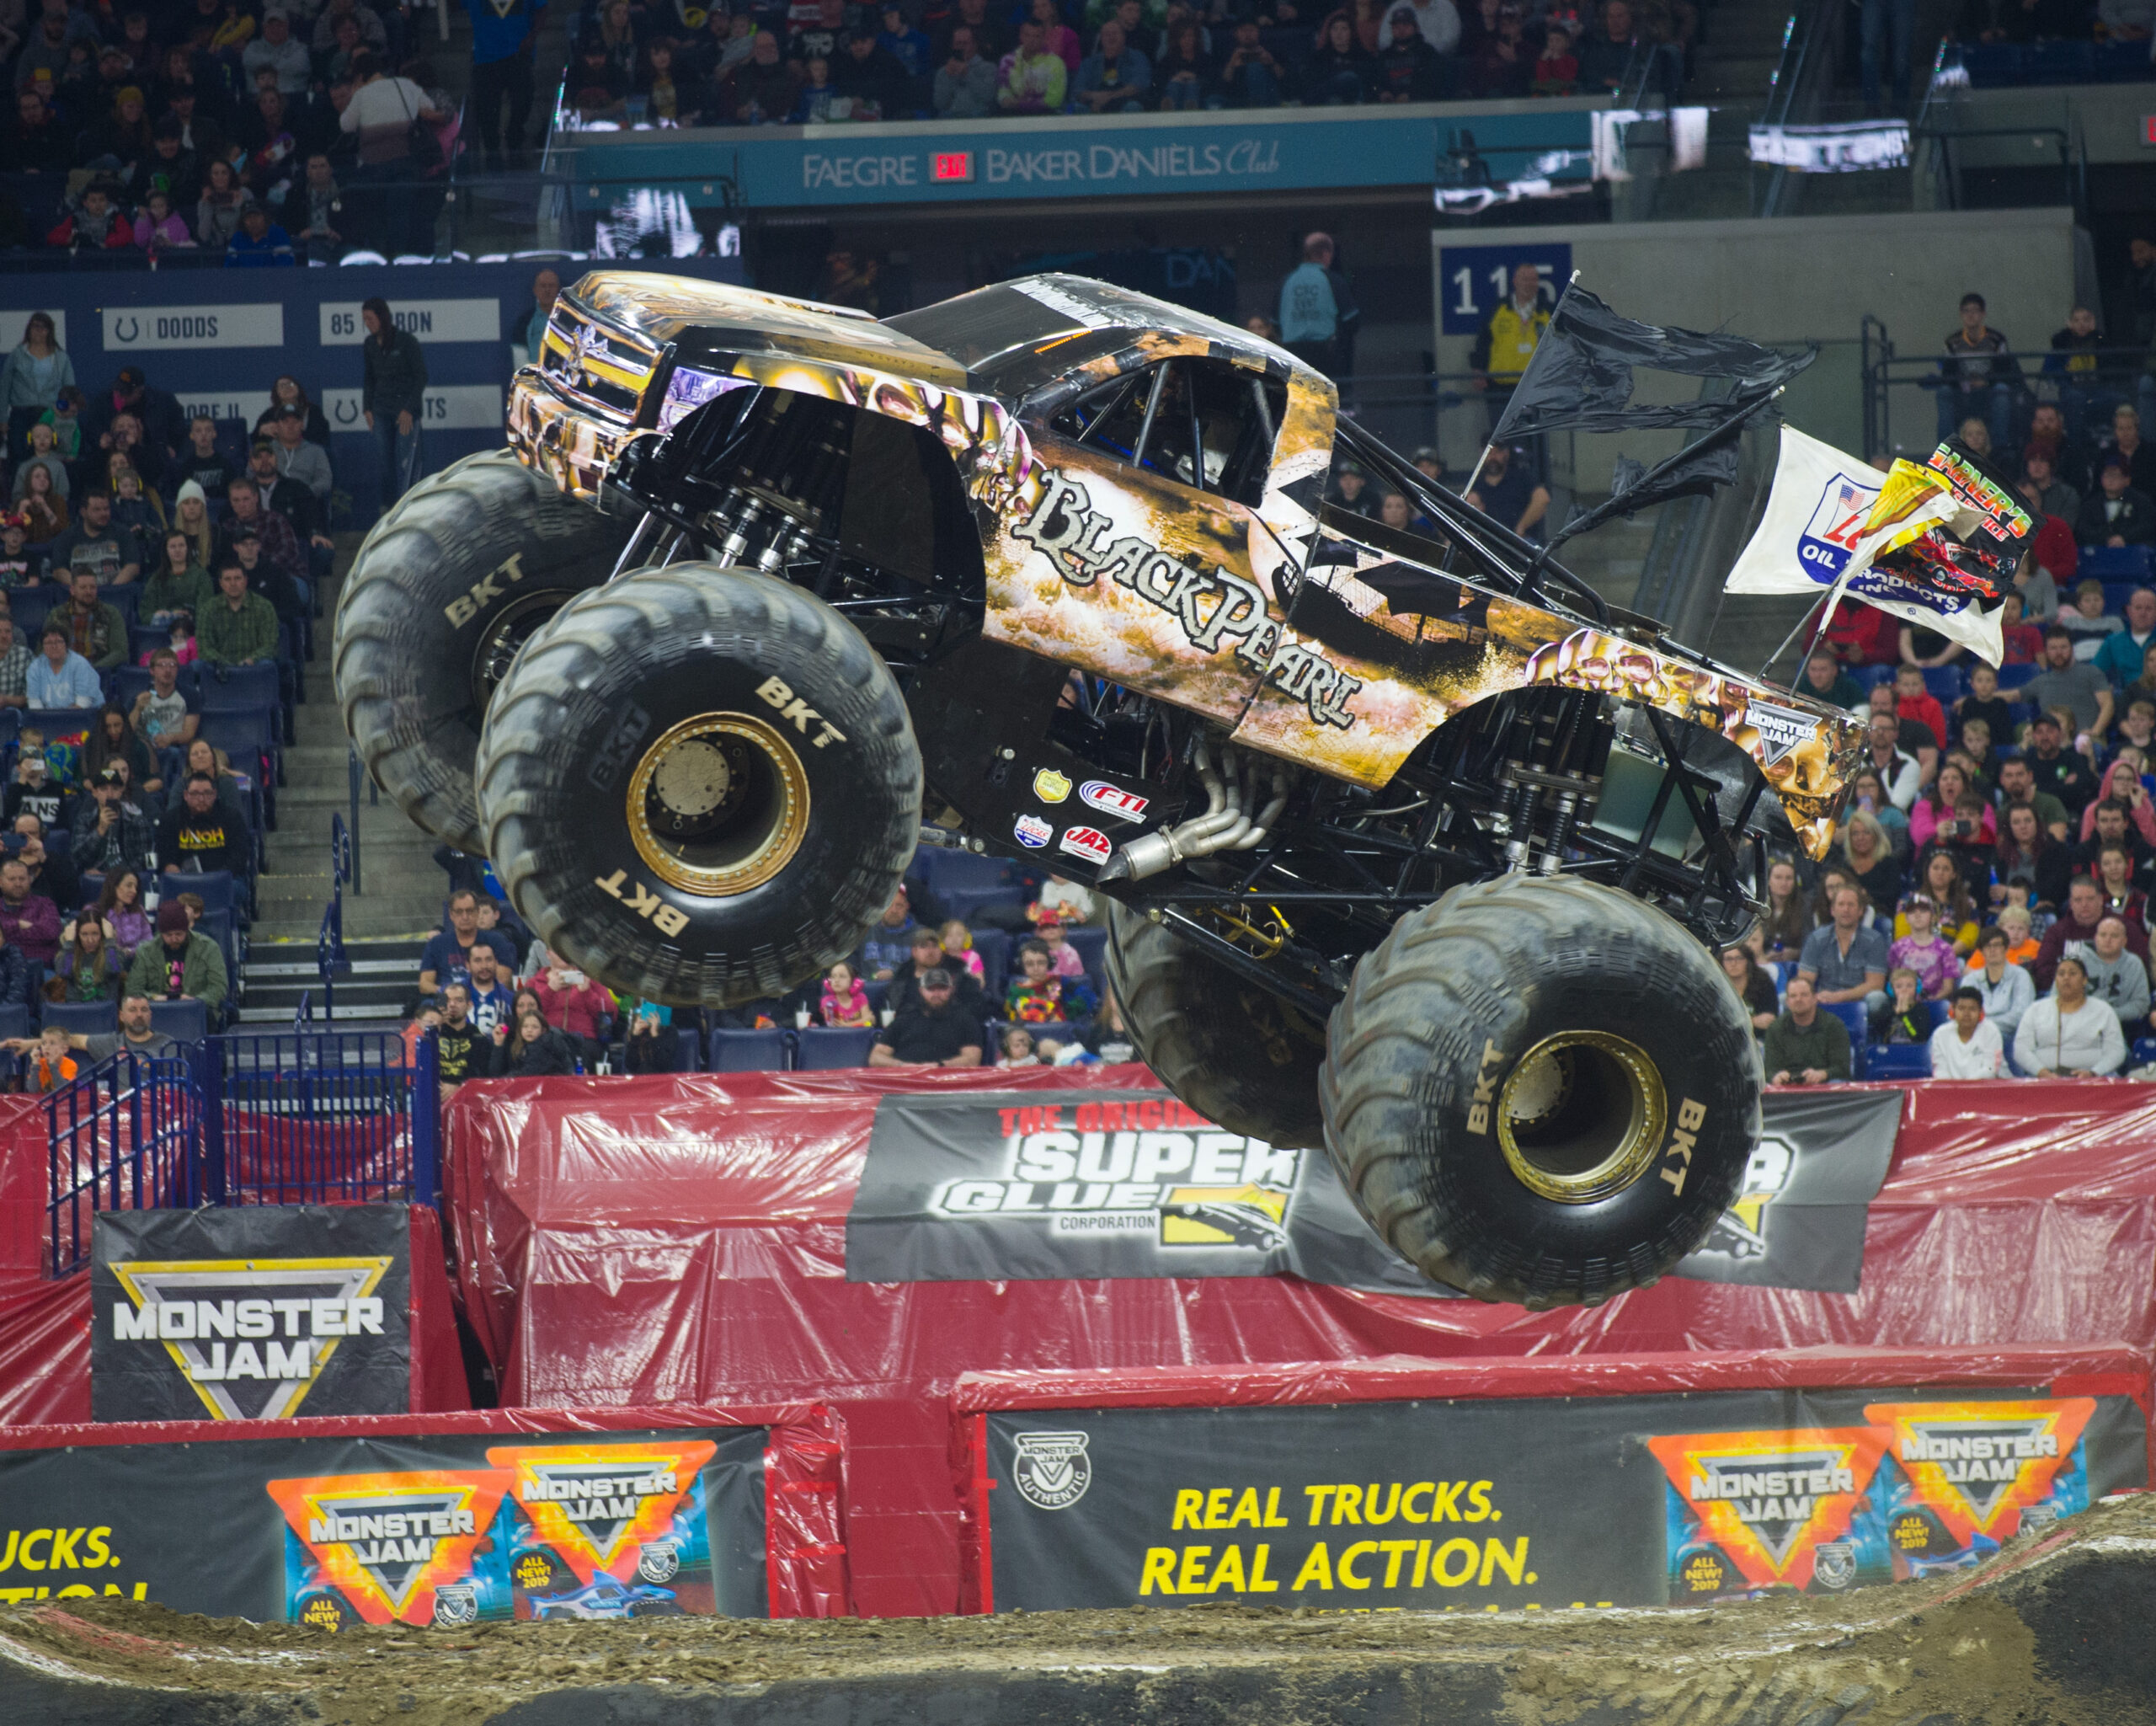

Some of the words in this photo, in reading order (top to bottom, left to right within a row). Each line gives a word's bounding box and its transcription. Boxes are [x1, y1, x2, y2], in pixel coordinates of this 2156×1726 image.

[803, 154, 918, 188] FAEGRE
[937, 154, 968, 179] EXIT
[987, 149, 1085, 183] BAKER
[1090, 144, 1221, 179] DANIELS
[1226, 140, 1280, 174] Club
[157, 317, 218, 339] DODDS
[331, 313, 355, 335] 85
[392, 311, 432, 334] RON
[445, 552, 524, 629] BKT
[1802, 544, 1836, 569] OIL
[1857, 567, 1960, 612] RODUCTS
[1011, 467, 1215, 639] BLACK
[1190, 564, 1363, 730] PEARL
[755, 676, 847, 748] BKT
[1745, 708, 1817, 744] MONSTER
[1762, 728, 1796, 747] JAM
[1095, 787, 1147, 813] FTI
[179, 826, 226, 844] UNOH
[1065, 827, 1111, 854] JAZ
[594, 868, 691, 938] BKT
[1466, 1038, 1505, 1136] BKT
[999, 1105, 1063, 1138] THE
[1075, 1099, 1211, 1135] ORIGIN
[1017, 1132, 1298, 1184] SUPER
[1660, 1097, 1707, 1198] BKT
[943, 1183, 1161, 1213] GLUE
[1059, 1216, 1156, 1231] CORPORATION
[114, 1297, 385, 1340] MONSTER
[191, 1340, 312, 1381] JAM
[1022, 1445, 1081, 1455] MONSTER
[1040, 1455, 1065, 1463] JAM
[1901, 1435, 2059, 1461] MONSTER
[1946, 1458, 2016, 1483] JAM
[522, 1472, 677, 1501] MONSTER
[1019, 1471, 1086, 1504] AUTHENTIC
[1690, 1468, 1854, 1500] MONSTER
[567, 1496, 636, 1521] JAM
[1171, 1487, 1289, 1530] REAL
[1305, 1480, 1502, 1526] TRUCKS.
[1740, 1496, 1812, 1522] JAM
[309, 1510, 475, 1543] MONSTER
[1895, 1527, 1929, 1539] NEW!
[1901, 1518, 1924, 1528] ALL
[358, 1536, 432, 1564] JAM
[1901, 1538, 1928, 1550] 2019
[516, 1566, 552, 1579] NEW!
[522, 1556, 545, 1568] ALL
[1139, 1543, 1280, 1595] REAL
[1291, 1536, 1539, 1591] ACTION.
[1685, 1568, 1723, 1580] NEW!
[1692, 1557, 1717, 1568] ALL
[523, 1576, 550, 1589] 2019
[1691, 1579, 1721, 1592] 2019
[304, 1611, 341, 1624] NEW!
[311, 1600, 334, 1611] ALL
